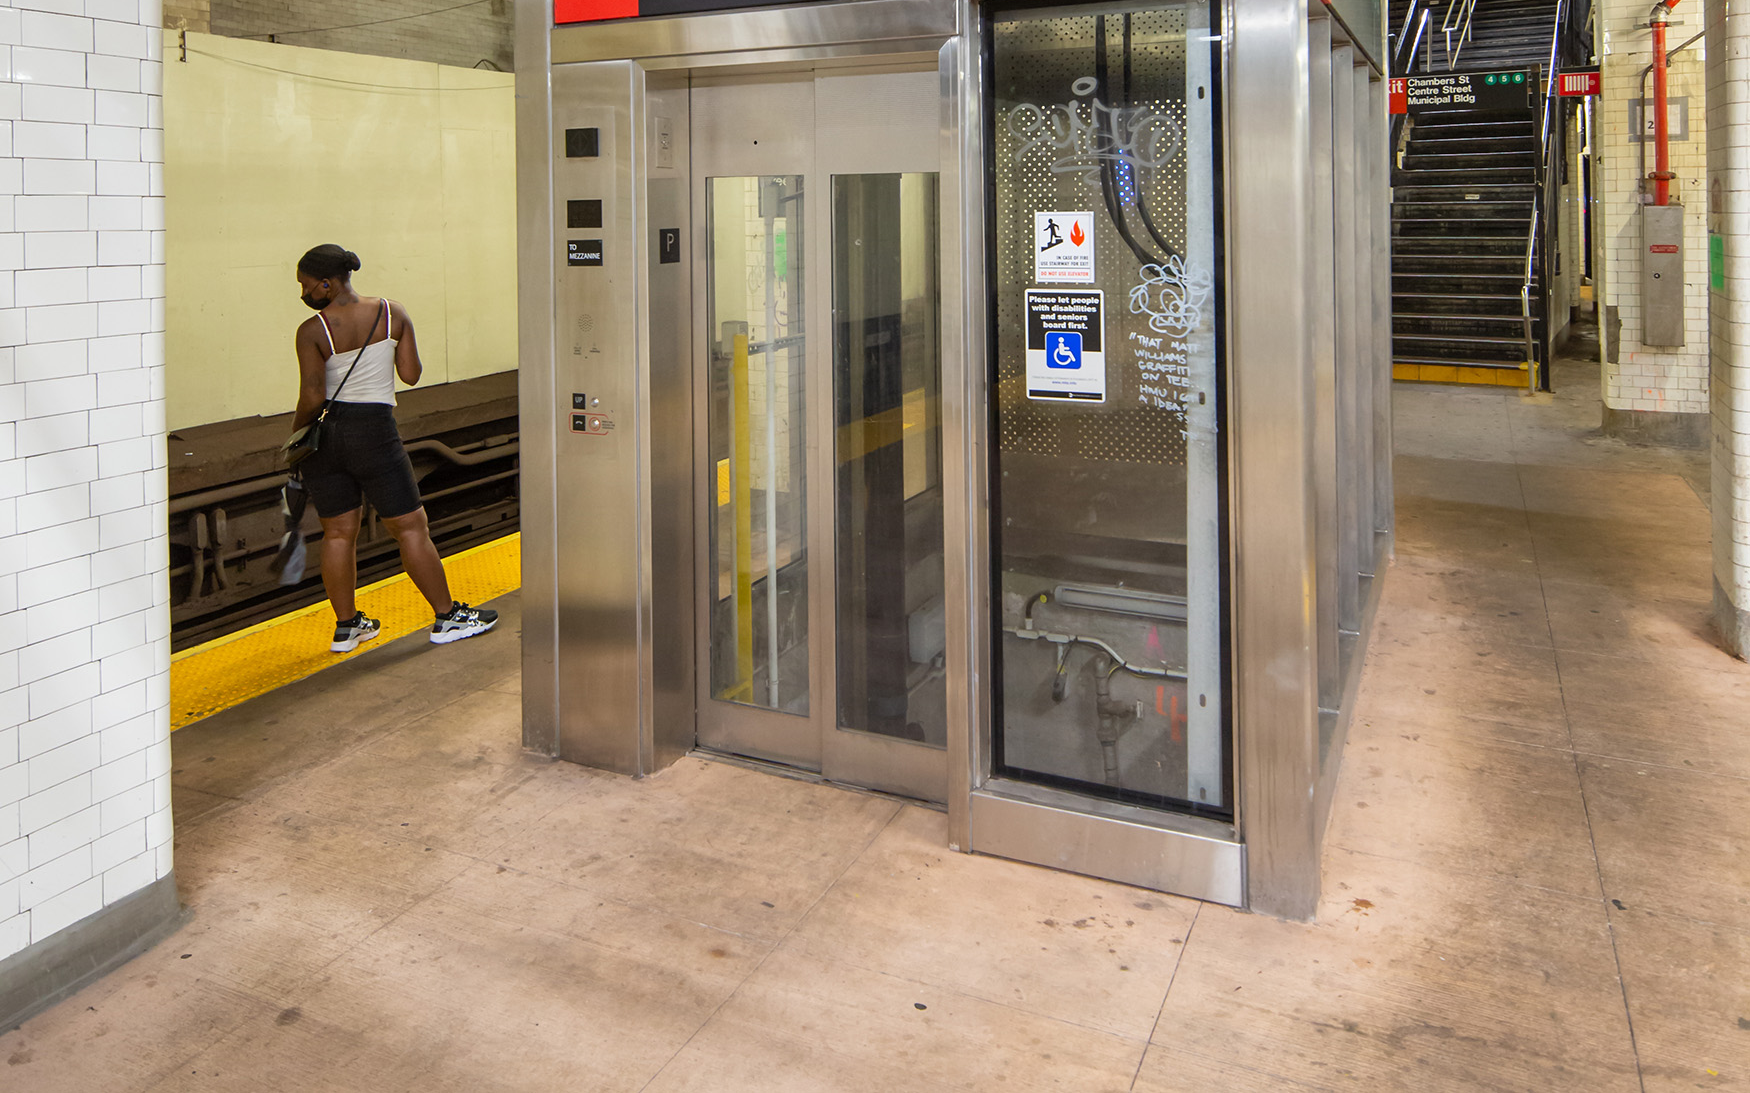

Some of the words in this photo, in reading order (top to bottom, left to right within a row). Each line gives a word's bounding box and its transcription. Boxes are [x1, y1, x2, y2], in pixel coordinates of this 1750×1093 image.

[1407, 77, 1456, 87] Chambers
[1458, 75, 1470, 84] St
[1407, 87, 1439, 96] Centre
[1442, 85, 1472, 94] Street
[1407, 95, 1451, 105] Municipal
[1453, 94, 1476, 104] Bldg
[569, 243, 577, 251] TO
[666, 233, 675, 252] P
[569, 252, 601, 260] MEZZANINE
[1058, 296, 1069, 304] let
[1071, 297, 1100, 305] people
[1031, 304, 1050, 312] with
[1051, 305, 1097, 313] disabilities
[1057, 313, 1088, 321] seniors
[1043, 321, 1067, 329] board
[1067, 322, 1088, 330] first.
[1134, 349, 1187, 365] WILLIAMS
[1141, 372, 1160, 382] ON
[1140, 384, 1168, 398] HMU
